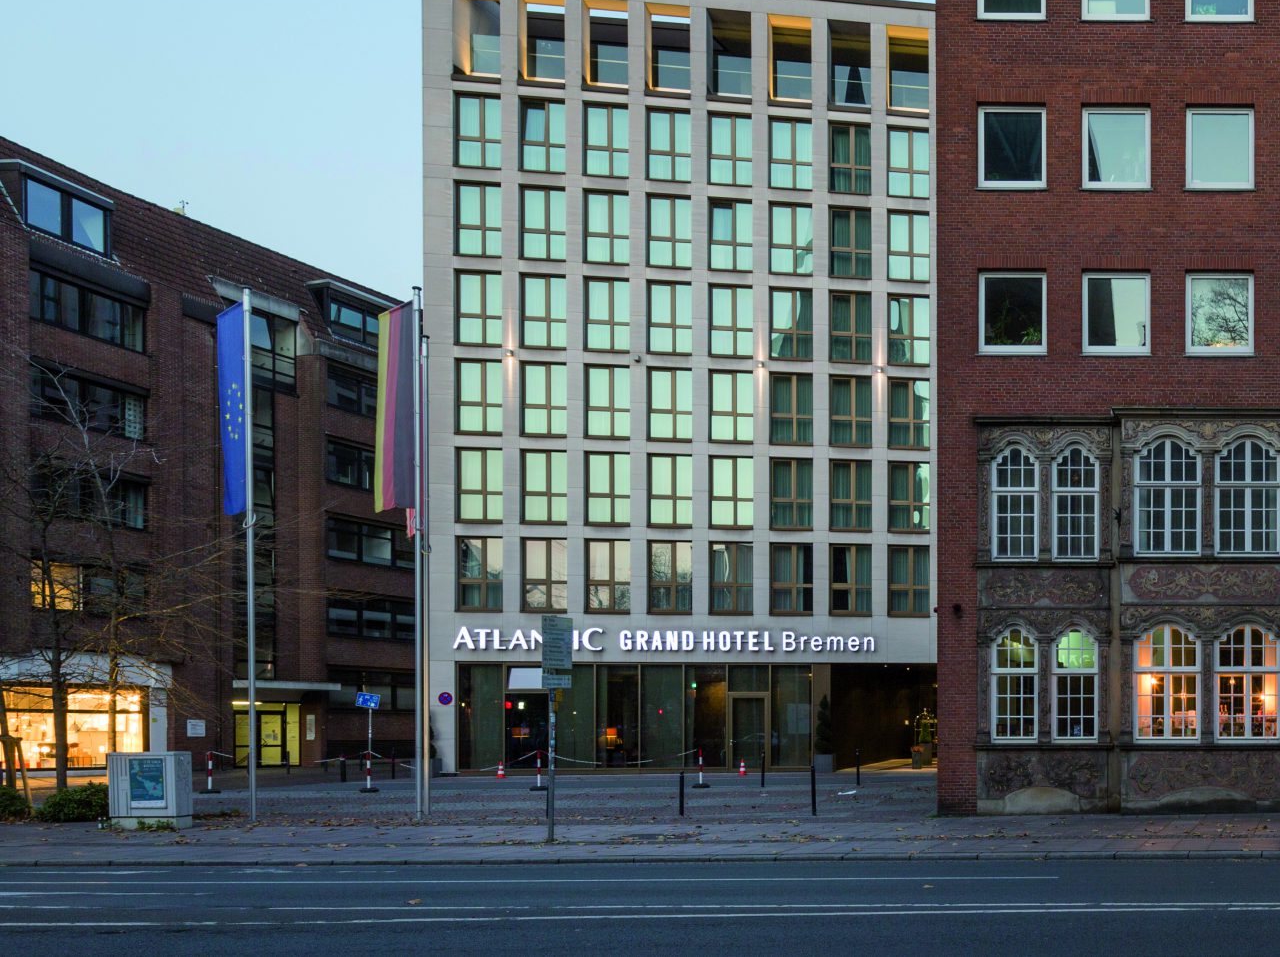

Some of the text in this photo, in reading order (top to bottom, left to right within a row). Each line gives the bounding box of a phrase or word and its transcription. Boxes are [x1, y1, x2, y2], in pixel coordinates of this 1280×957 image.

[452, 625, 604, 651] ATLANIC
[618, 629, 695, 651] GRAND
[702, 630, 775, 652] HOTEL
[781, 630, 876, 652] Bremen
